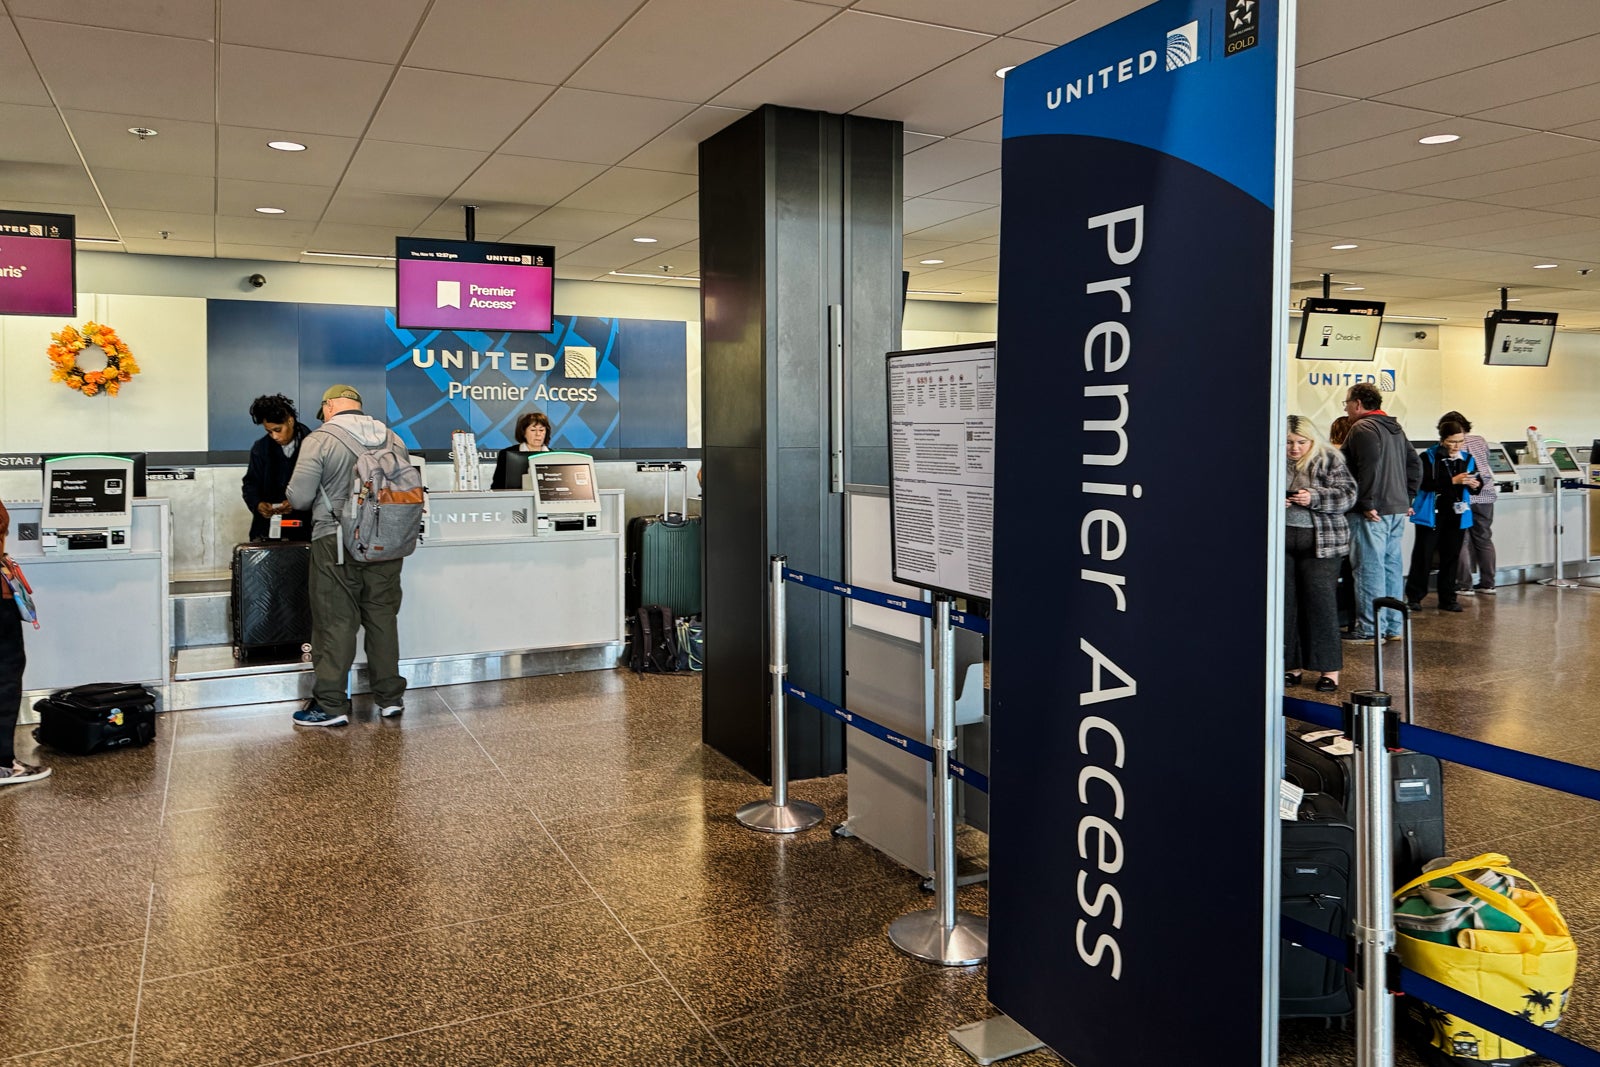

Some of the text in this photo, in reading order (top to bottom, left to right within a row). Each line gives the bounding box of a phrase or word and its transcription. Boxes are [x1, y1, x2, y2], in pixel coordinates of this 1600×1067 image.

[1228, 36, 1255, 52] GOLD
[1046, 50, 1158, 110] UNITED
[0, 224, 28, 233] ITED
[486, 254, 521, 263] UNITED
[469, 284, 516, 297] Premier
[412, 348, 556, 372] UNITED
[1309, 372, 1376, 386] UNITED
[448, 382, 598, 402] Premier Access
[0, 457, 34, 466] STAR
[1076, 205, 1144, 981] Premier Access
